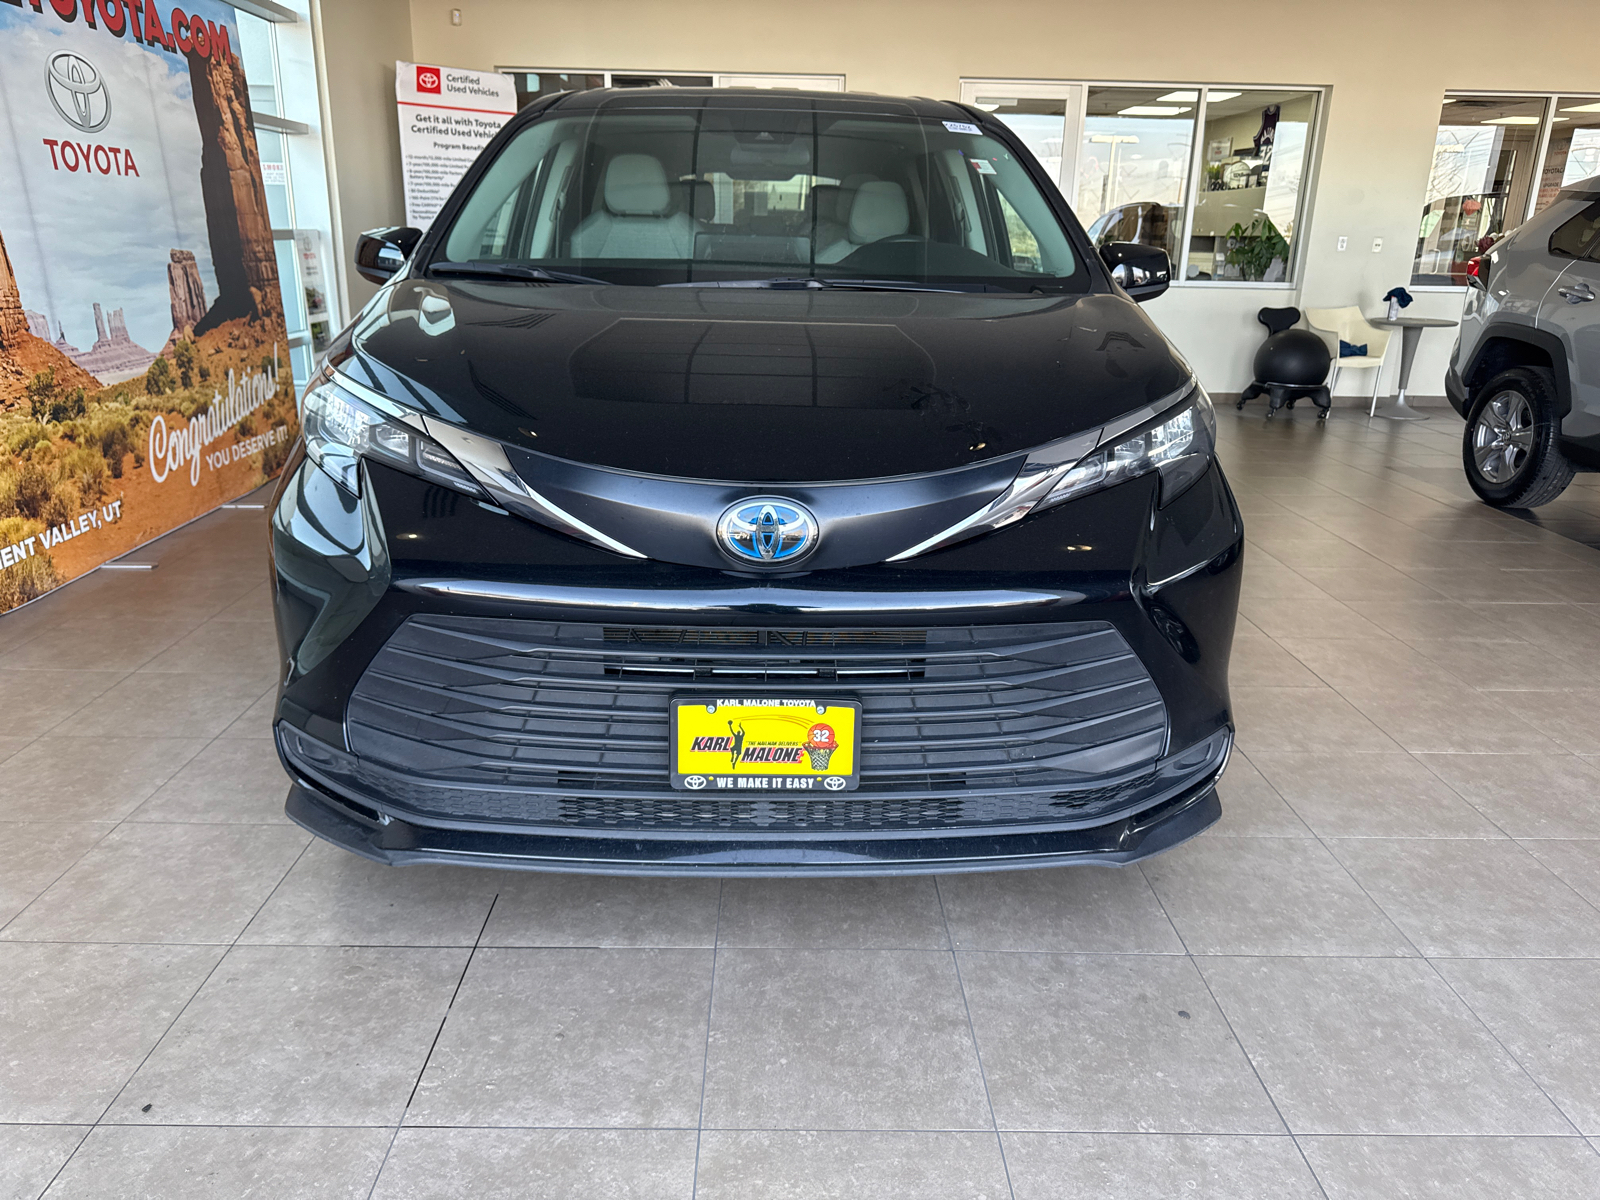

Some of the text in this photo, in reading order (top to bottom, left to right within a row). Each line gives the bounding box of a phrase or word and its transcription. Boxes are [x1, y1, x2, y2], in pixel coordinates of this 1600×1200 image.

[446, 73, 480, 85] Certified
[446, 84, 499, 97] Used Vehicles
[415, 113, 502, 130] Get it all with Toyota
[411, 125, 499, 139] Certified Used Vehic
[433, 142, 462, 151] Program
[42, 138, 140, 177] TOYOTA
[149, 341, 280, 487] Congratulations!
[205, 425, 289, 471] YOU DESERVE IT!
[38, 509, 102, 550] VALLEY,
[102, 500, 122, 522] UT
[716, 699, 817, 708] KARL MALONE TOYOTA
[813, 729, 830, 742] 32
[690, 736, 734, 752] KARL
[740, 747, 803, 763] MALONE
[716, 777, 815, 789] WE MAKE IT EASY
